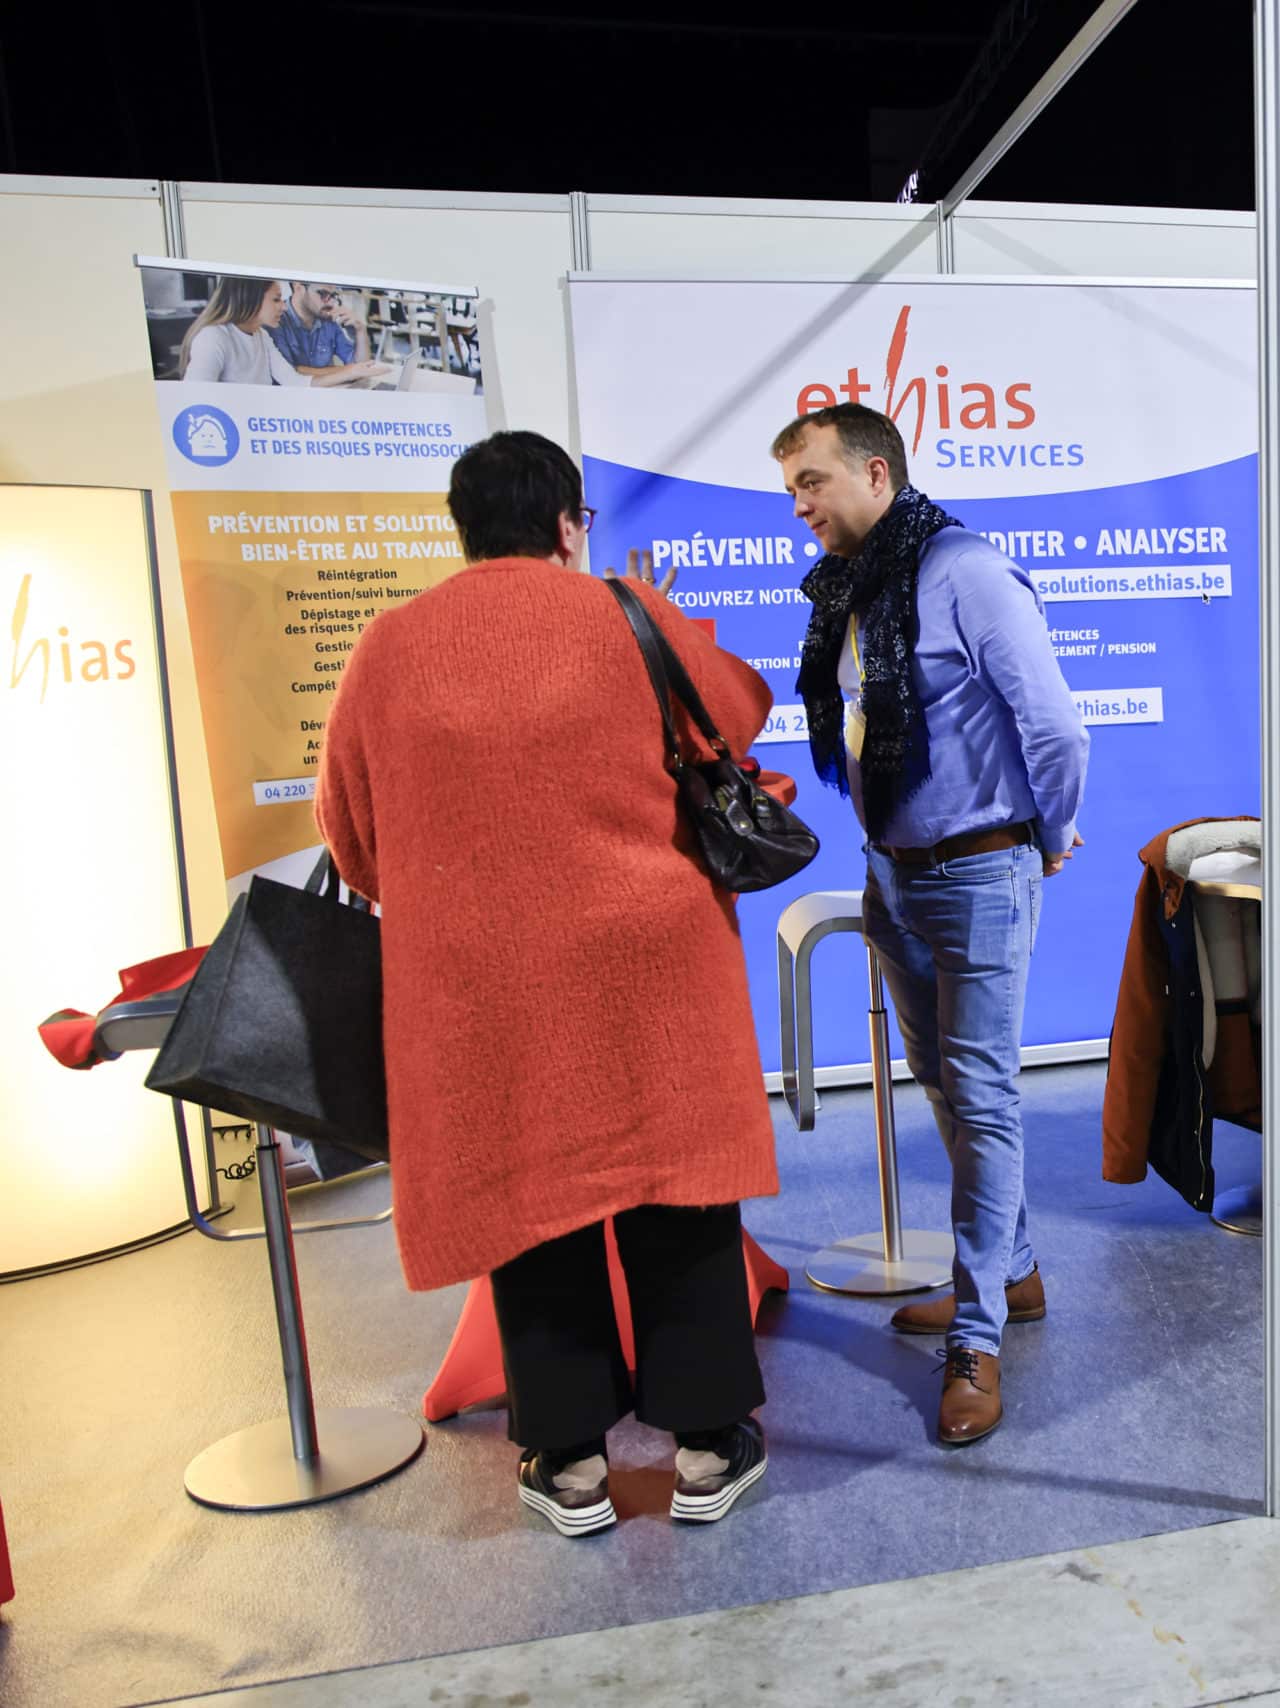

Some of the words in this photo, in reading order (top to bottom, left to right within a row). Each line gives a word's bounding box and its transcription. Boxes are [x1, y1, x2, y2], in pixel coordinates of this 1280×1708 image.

[796, 305, 1036, 456] ethias
[248, 417, 313, 434] GESTION
[319, 420, 347, 435] DES
[351, 421, 452, 438] COMPETENCES
[250, 439, 267, 454] ET
[273, 440, 300, 455] DES
[306, 441, 371, 457] RISQUES
[375, 442, 471, 458] PSYCHOSOCI
[936, 439, 1084, 468] SERVICES
[208, 511, 340, 533] PRÉVENTION
[346, 515, 368, 532] ET
[374, 514, 456, 532] SOLUTIO
[241, 539, 347, 562] BIEN-ÊTRE
[352, 543, 378, 560] AU
[383, 541, 463, 558] TRAVAIL
[652, 531, 795, 568] PRÉVENIR
[979, 531, 1066, 558] DITER
[1095, 527, 1229, 556] ANALYSER
[317, 569, 398, 582] Réintégration
[286, 587, 384, 601] Prévention/suivi
[387, 587, 430, 598] burno
[666, 588, 753, 608] ÉCOUVREZ
[1038, 572, 1225, 594] solutions.ethias.be
[301, 608, 360, 622] Dépistage
[364, 608, 375, 617] et
[285, 624, 306, 635] des
[310, 622, 354, 635] risques
[1048, 628, 1100, 641] ÉTENCES
[10, 573, 136, 704] hias
[315, 641, 353, 653] Gestio
[1052, 645, 1097, 657] GEMENT
[1108, 643, 1156, 655] PENSION
[314, 660, 345, 672] Gesti
[746, 657, 790, 669] ESTION
[291, 681, 337, 694] Compét
[265, 787, 280, 799] 04
[284, 784, 306, 797] 220
